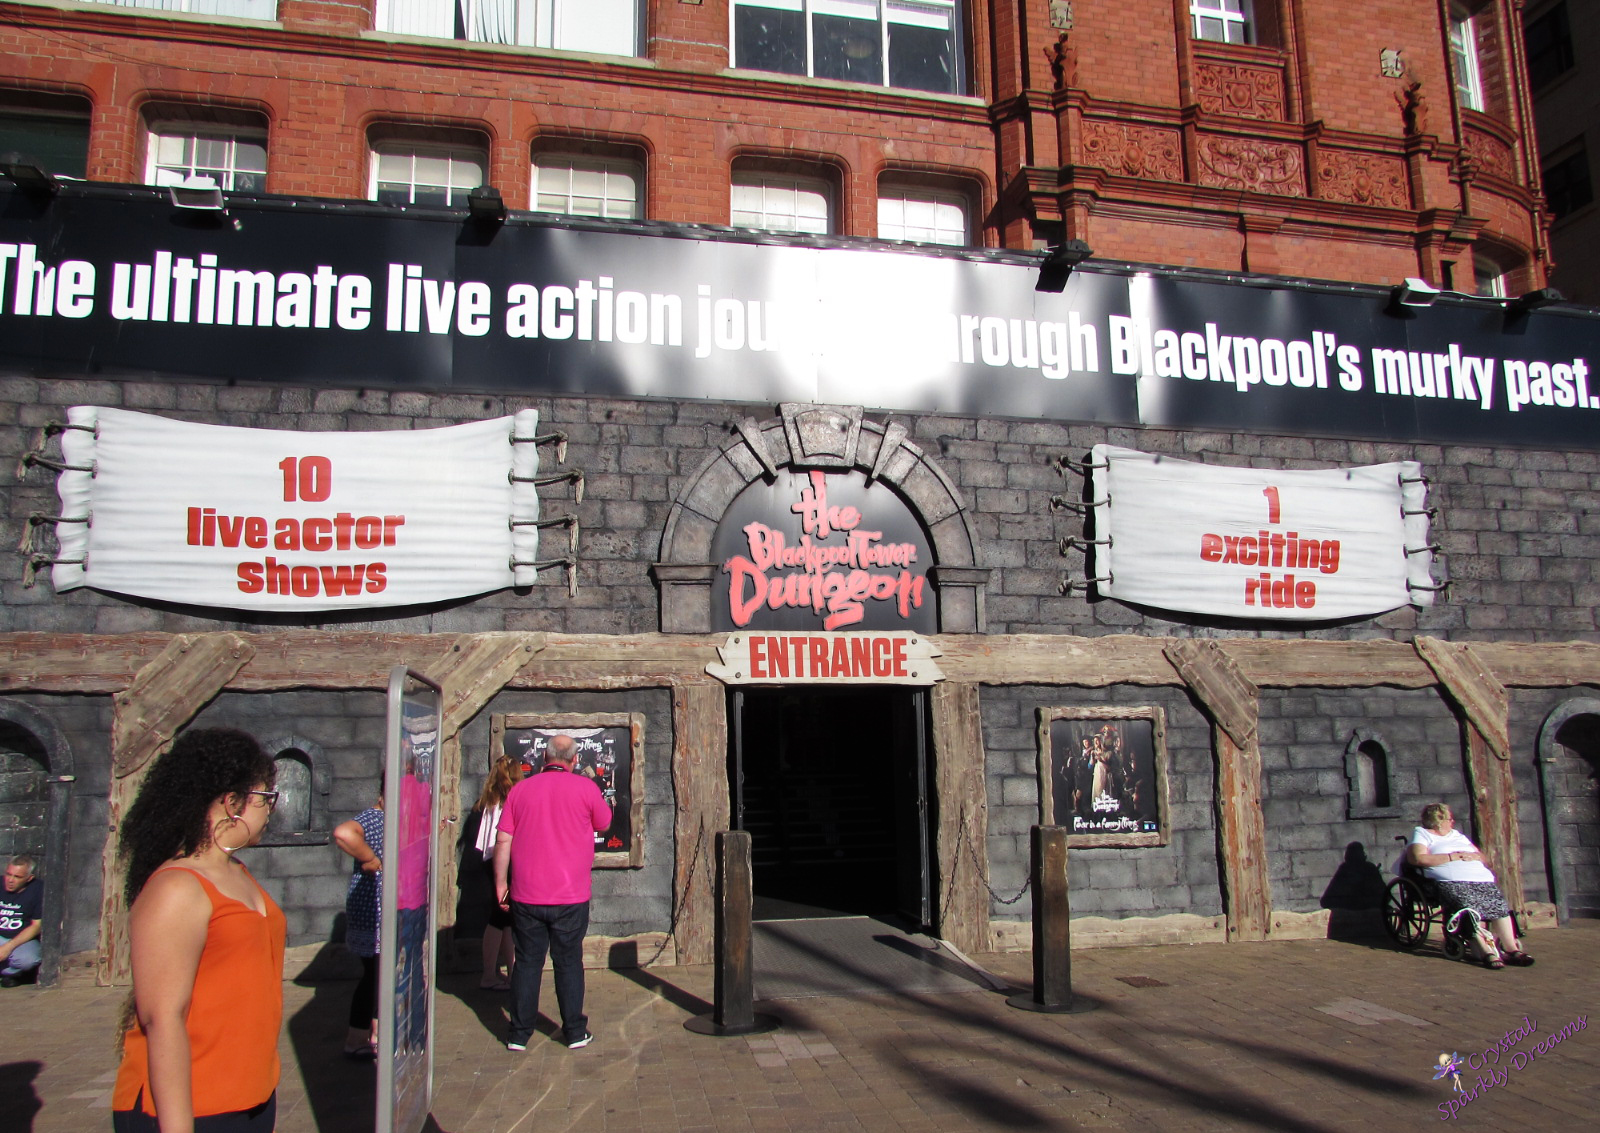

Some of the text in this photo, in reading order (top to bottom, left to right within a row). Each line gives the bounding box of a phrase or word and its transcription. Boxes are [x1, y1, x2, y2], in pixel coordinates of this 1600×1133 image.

[111, 251, 371, 330] ultimate
[386, 263, 490, 336] live
[505, 276, 682, 347] action
[946, 311, 1098, 380] rough
[1110, 314, 1362, 392] Blackpool's
[1372, 343, 1494, 410] murky
[279, 456, 332, 502] 10
[791, 471, 862, 539] the
[1263, 486, 1281, 524] 1
[187, 507, 405, 551] live actor
[1200, 530, 1341, 574] exciting
[237, 556, 387, 597] shows
[723, 555, 925, 631] Dungeon
[1245, 573, 1316, 609] ride
[749, 636, 908, 678] ENTRANCE
